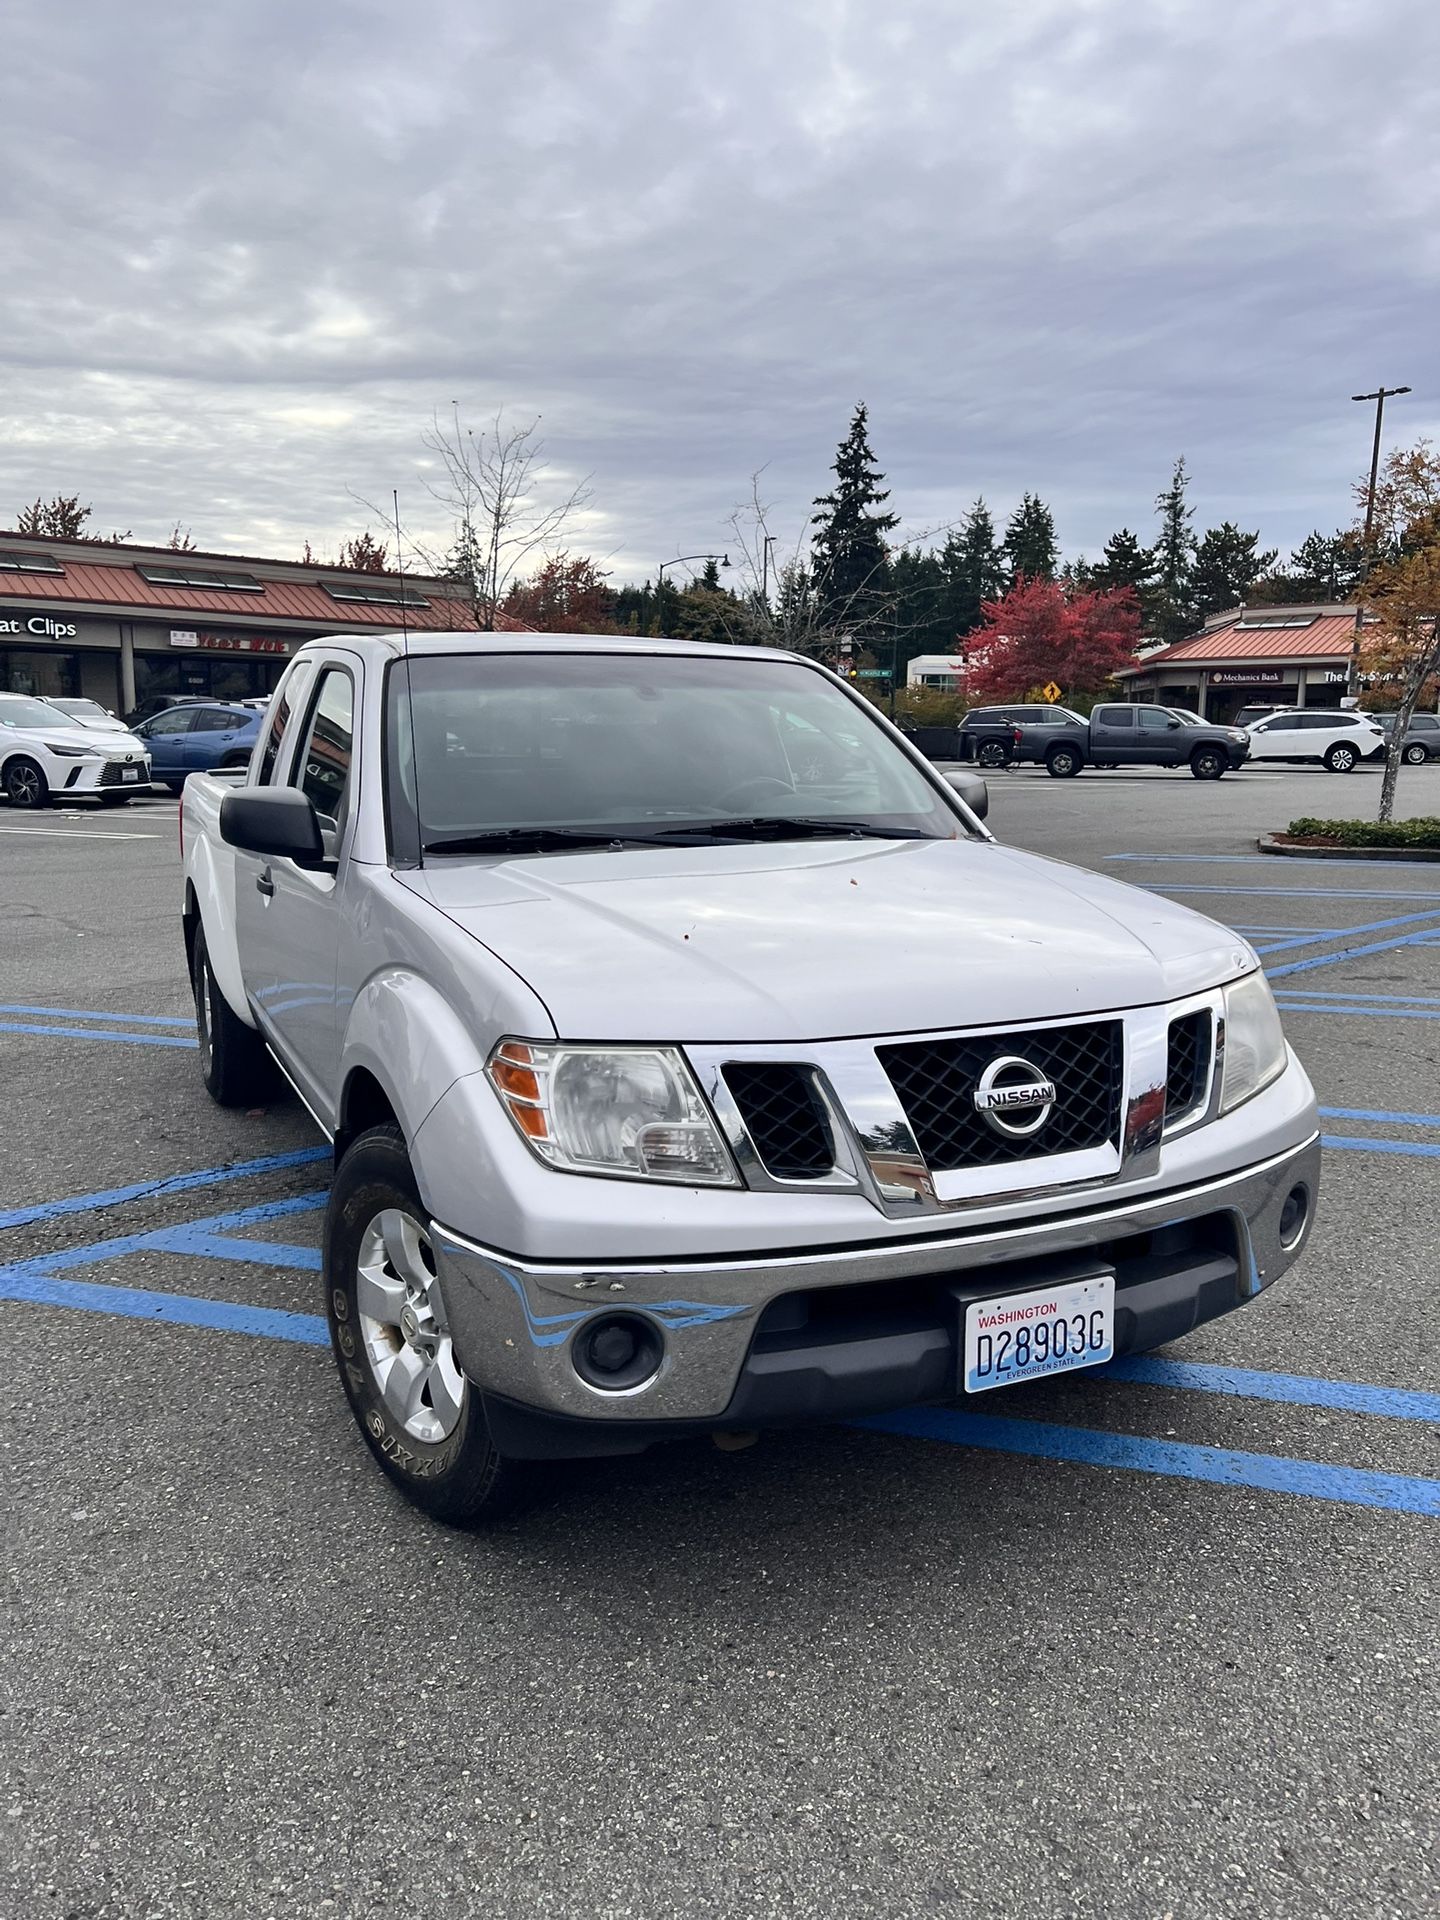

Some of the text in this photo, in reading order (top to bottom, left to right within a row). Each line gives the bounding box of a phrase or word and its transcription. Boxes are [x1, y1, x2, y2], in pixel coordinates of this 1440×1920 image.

[27, 617, 77, 640] Clips
[1223, 672, 1279, 682] Mechanics Bank
[1324, 671, 1343, 682] The
[987, 1085, 1052, 1107] NISSAN
[978, 1302, 1058, 1329] WASHINGTON
[977, 1310, 1104, 1378] D28903G
[1006, 1358, 1076, 1380] EVERGREEN STATE
